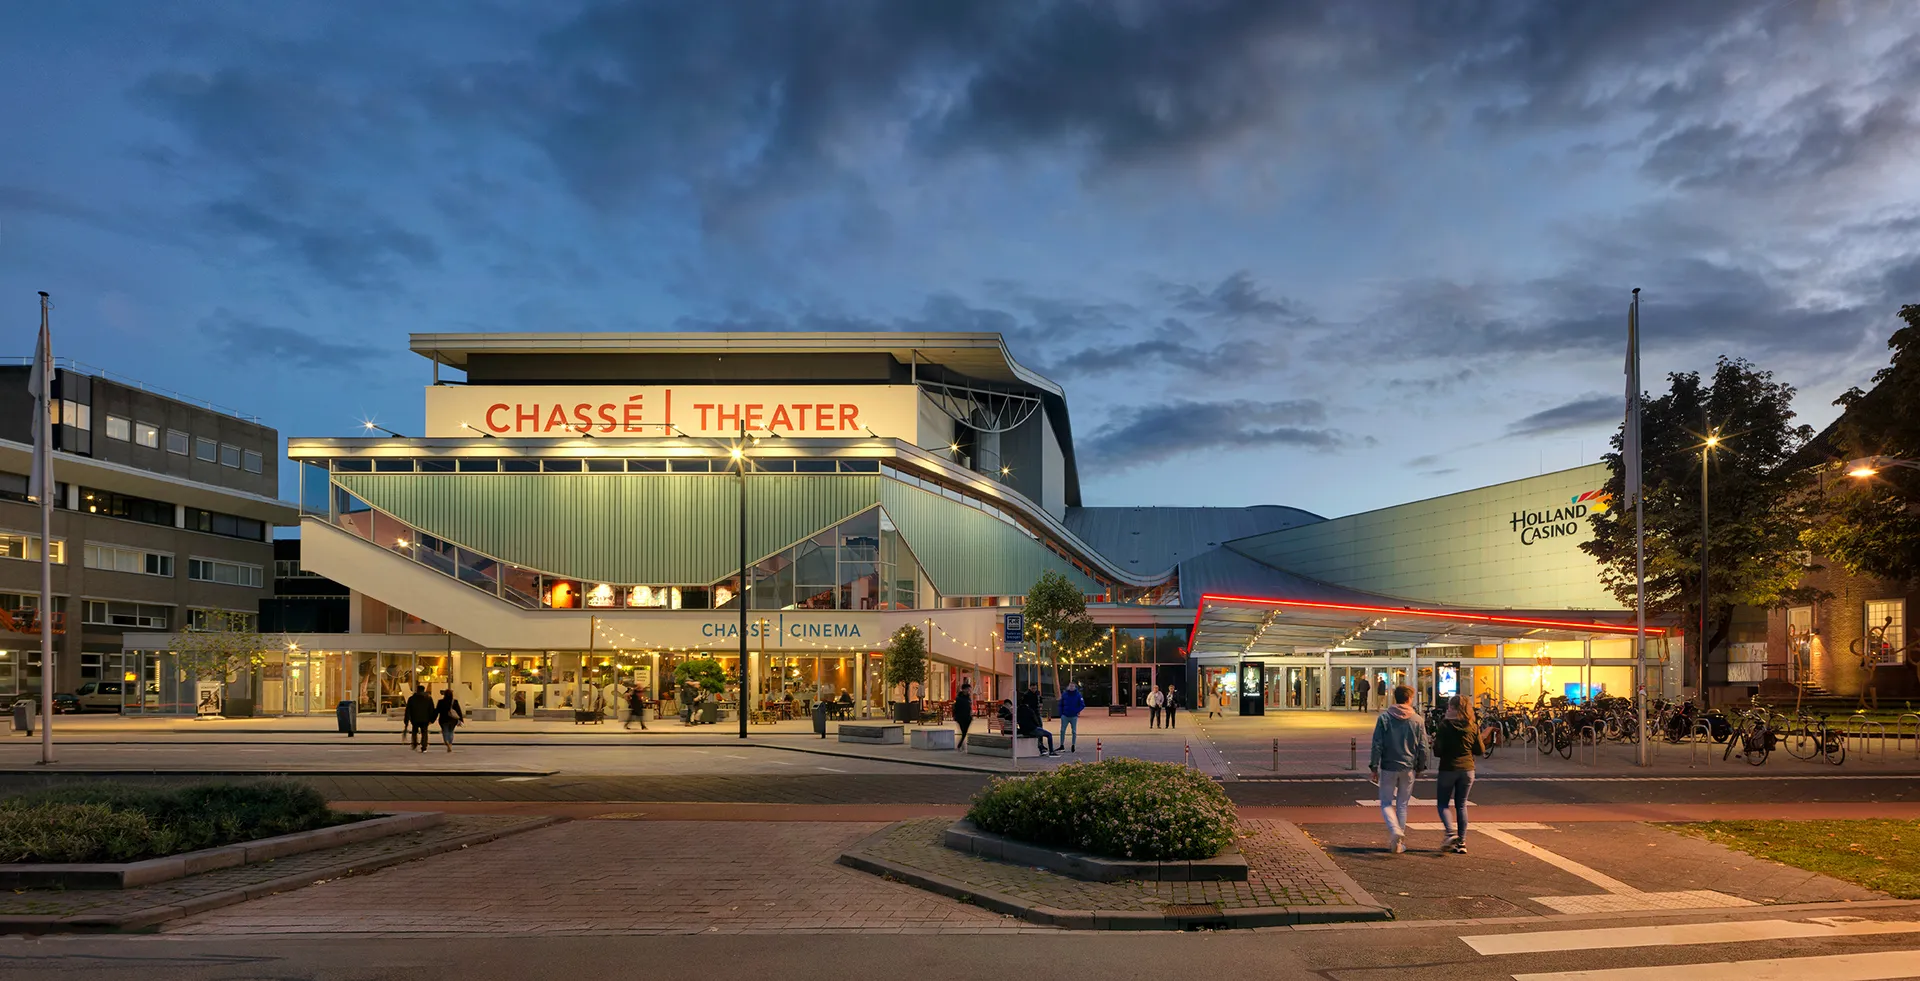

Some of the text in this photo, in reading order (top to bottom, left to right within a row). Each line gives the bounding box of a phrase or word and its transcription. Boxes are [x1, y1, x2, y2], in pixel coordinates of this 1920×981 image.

[486, 394, 860, 433] CHASSÉ THEATER
[1509, 504, 1587, 532] HOLLAND
[1521, 522, 1578, 545] CASINO
[702, 620, 861, 637] CHASÉ CINEMA
